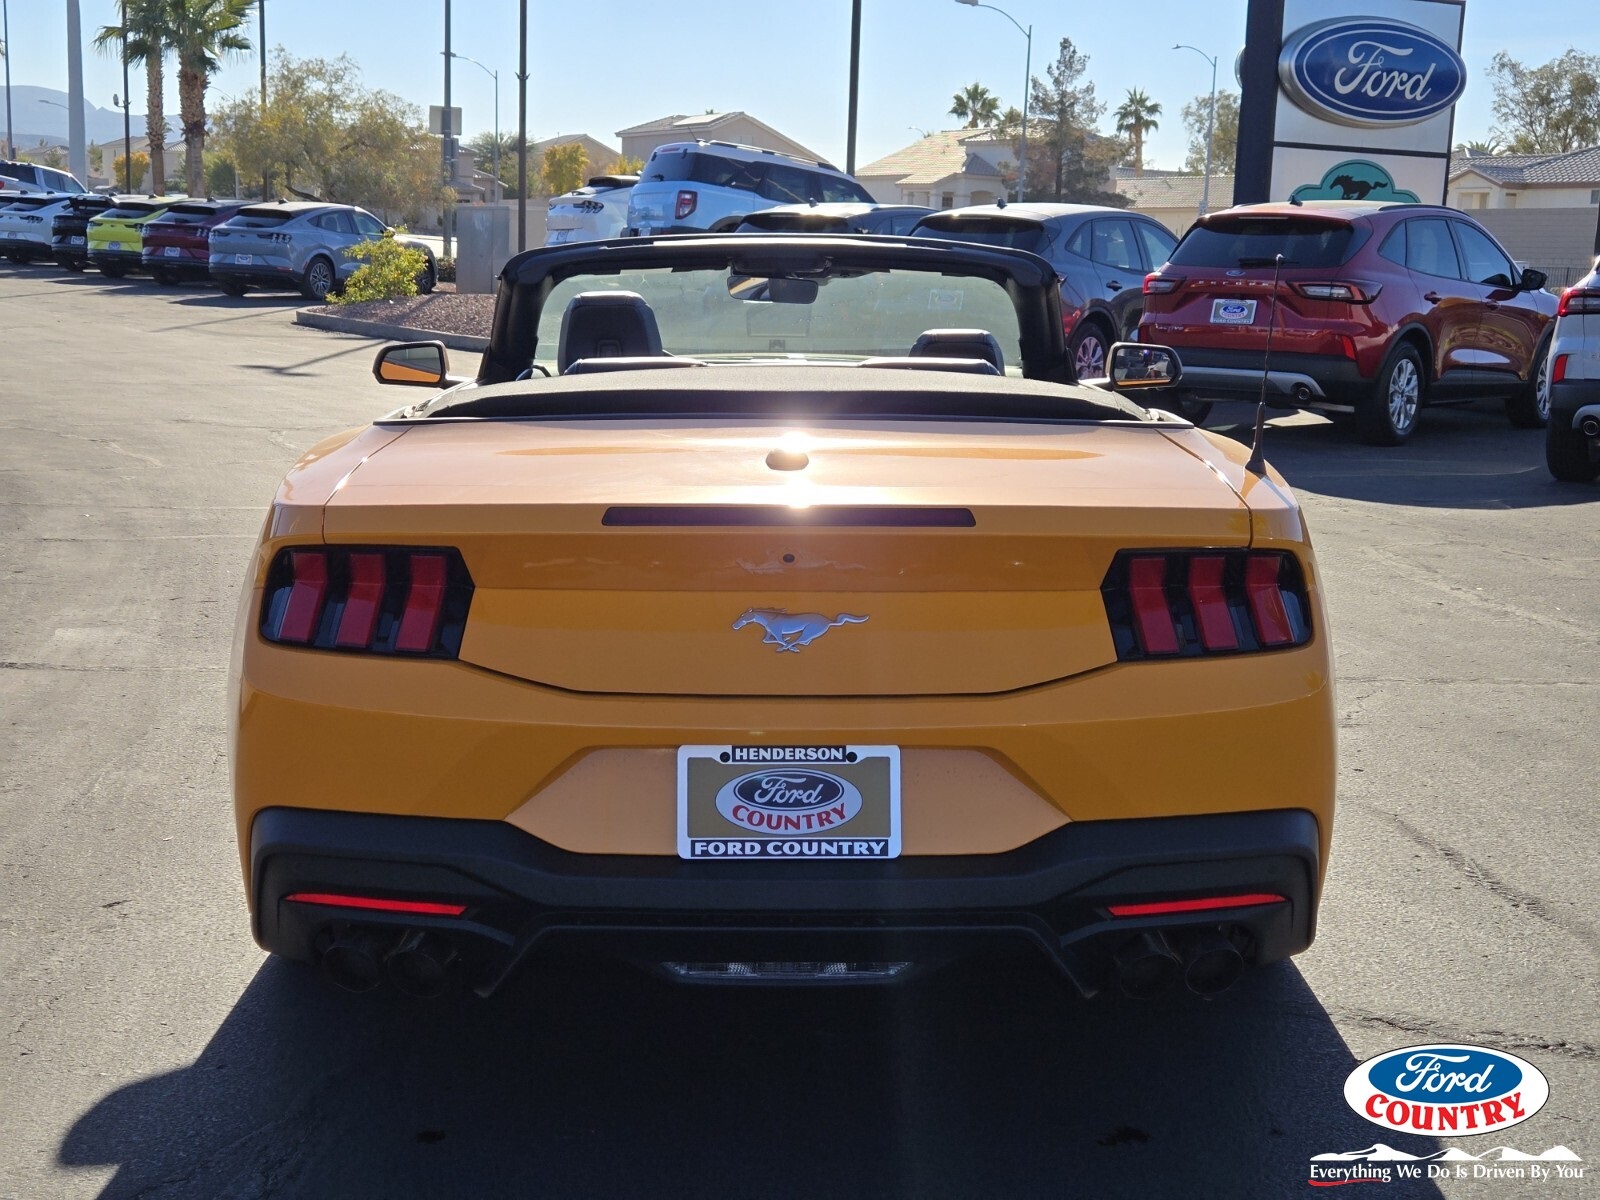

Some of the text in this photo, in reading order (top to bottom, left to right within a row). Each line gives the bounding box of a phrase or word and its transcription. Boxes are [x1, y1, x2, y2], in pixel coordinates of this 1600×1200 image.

[1334, 40, 1436, 101] Ford
[735, 747, 843, 761] HENDERSON
[754, 776, 824, 804] Ford
[732, 802, 846, 831] COUNTRY
[694, 841, 886, 855] FORD COUNTRY
